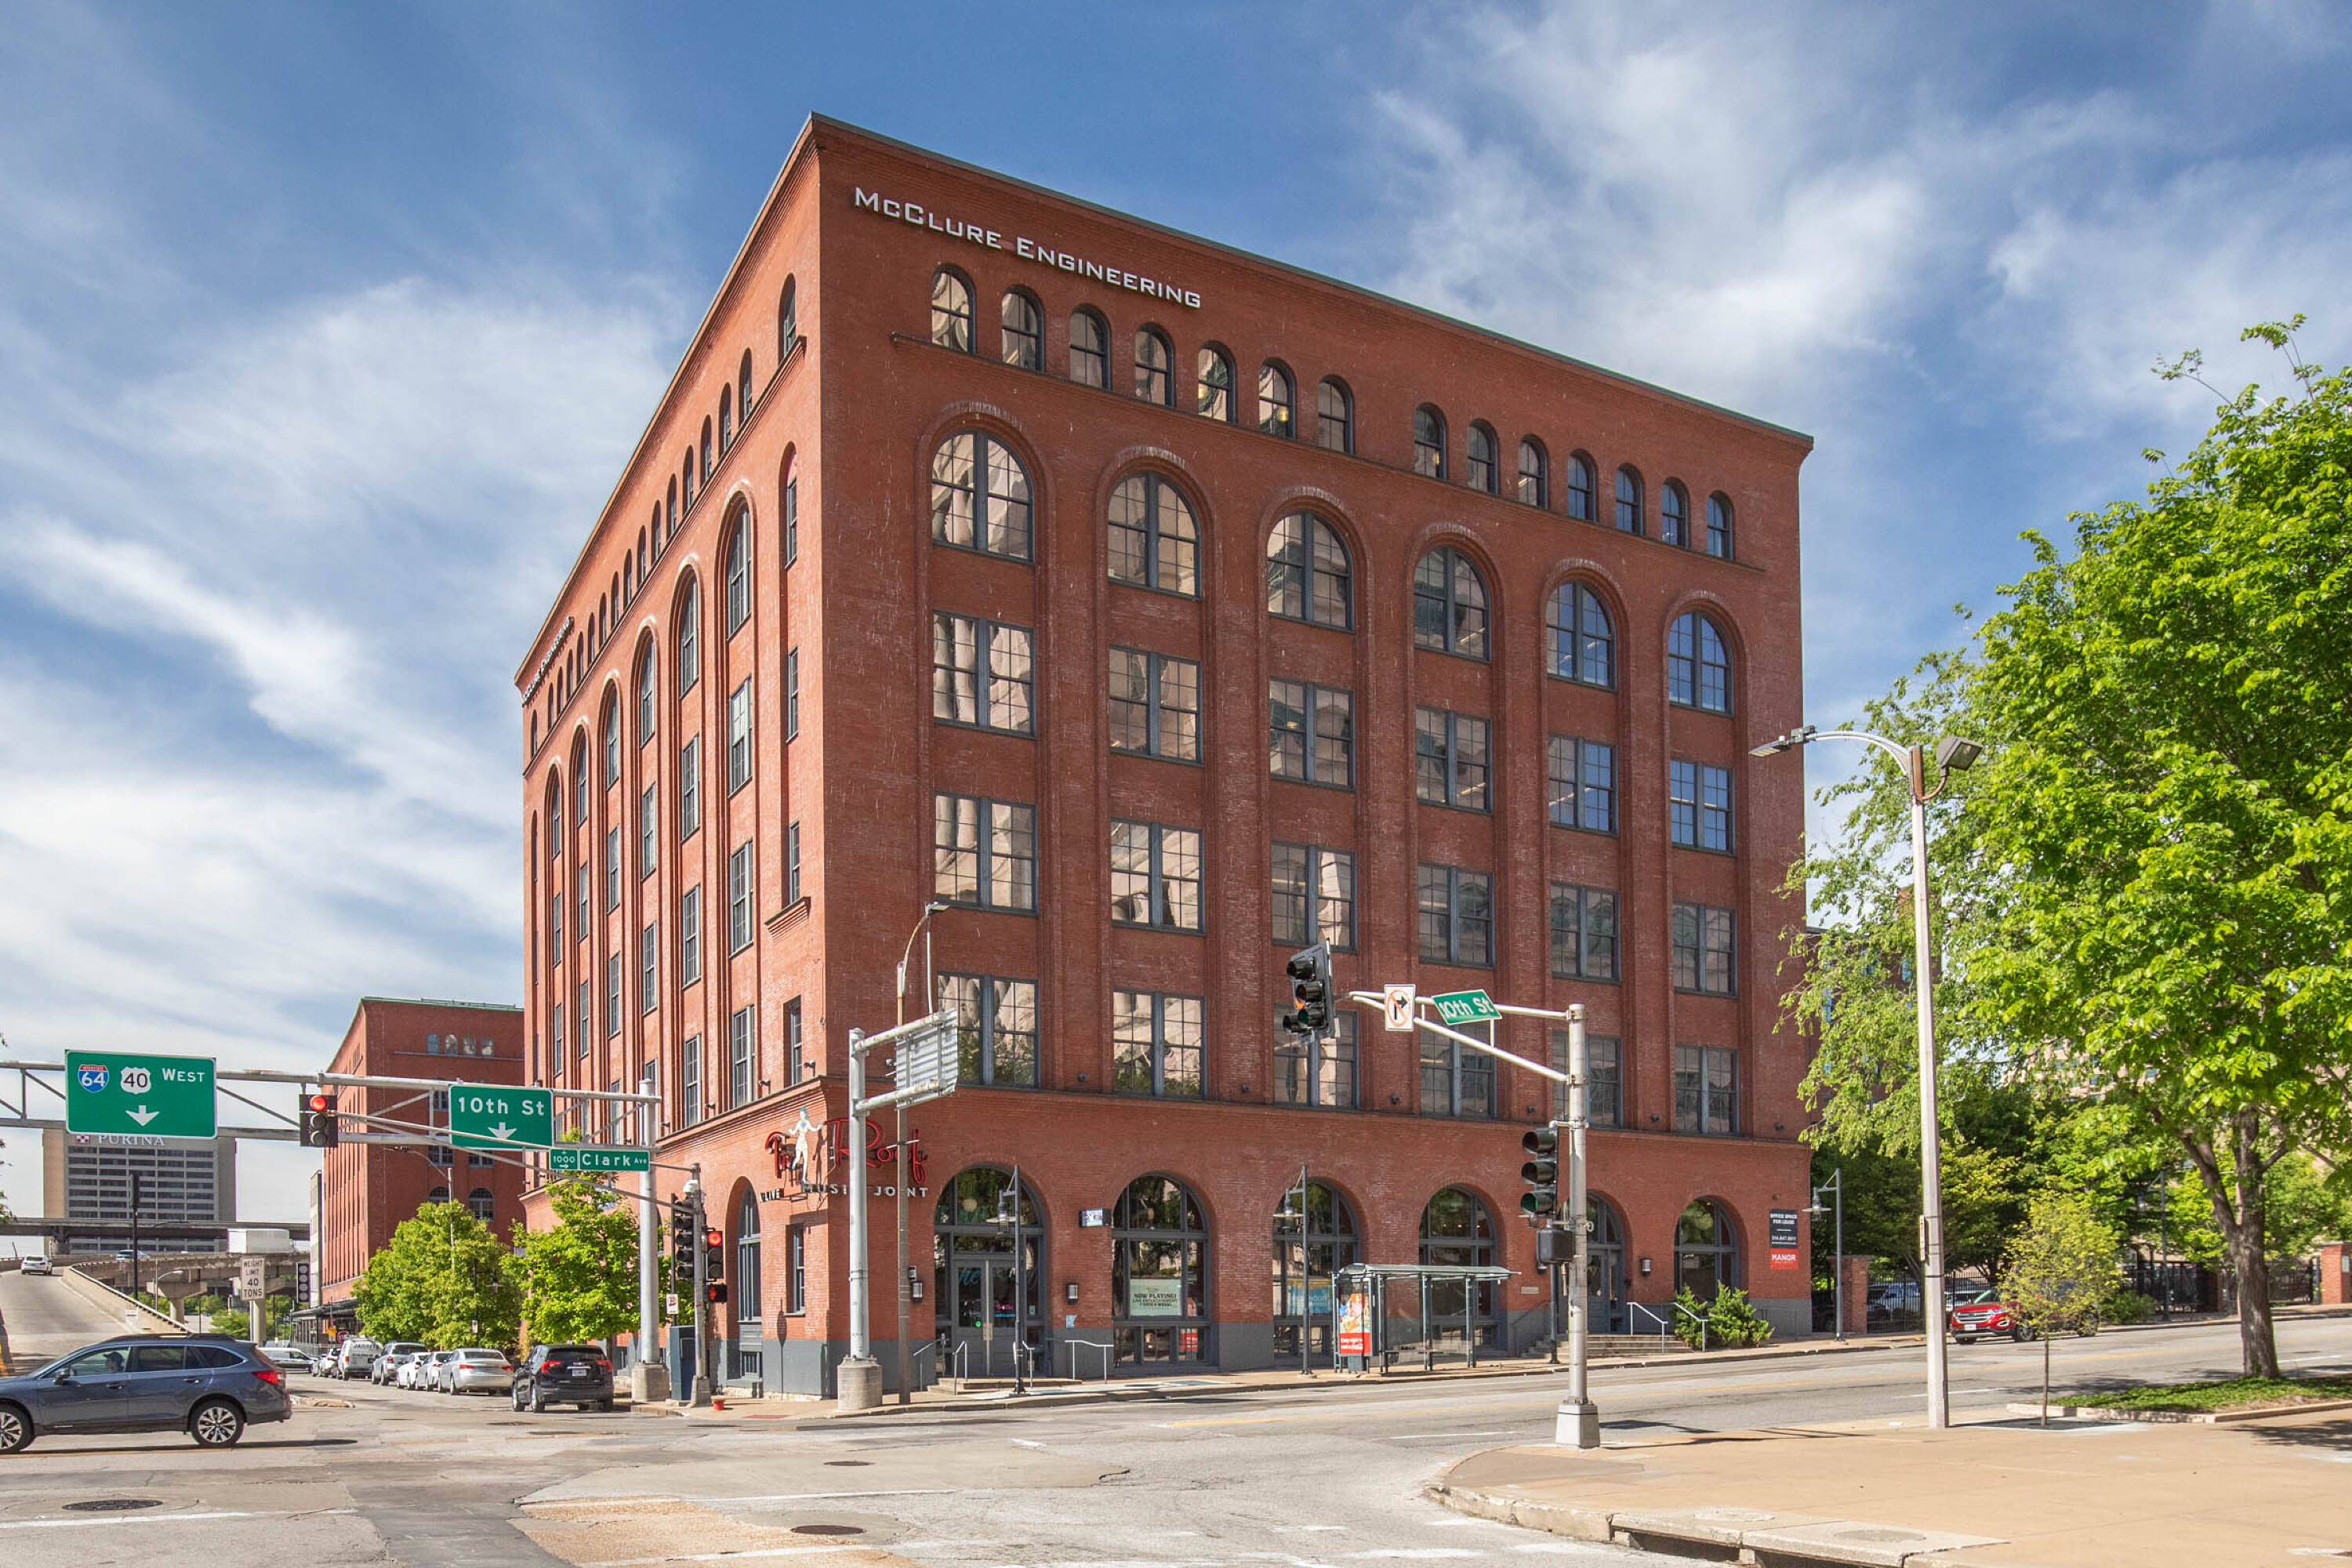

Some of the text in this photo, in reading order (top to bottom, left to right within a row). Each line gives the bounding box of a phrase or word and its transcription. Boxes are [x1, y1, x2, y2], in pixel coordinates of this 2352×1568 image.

[1439, 996, 1494, 1018] 10th St
[81, 1068, 205, 1088] 64 40 WEST
[458, 1098, 545, 1116] 10th St
[98, 1134, 165, 1146] PURINA
[553, 1155, 575, 1163] 1000
[582, 1153, 630, 1167] Clark
[802, 1183, 848, 1195] MUSI
[873, 1186, 928, 1198] JONT
[247, 1278, 259, 1287] 40
[244, 1288, 263, 1298] TONS
